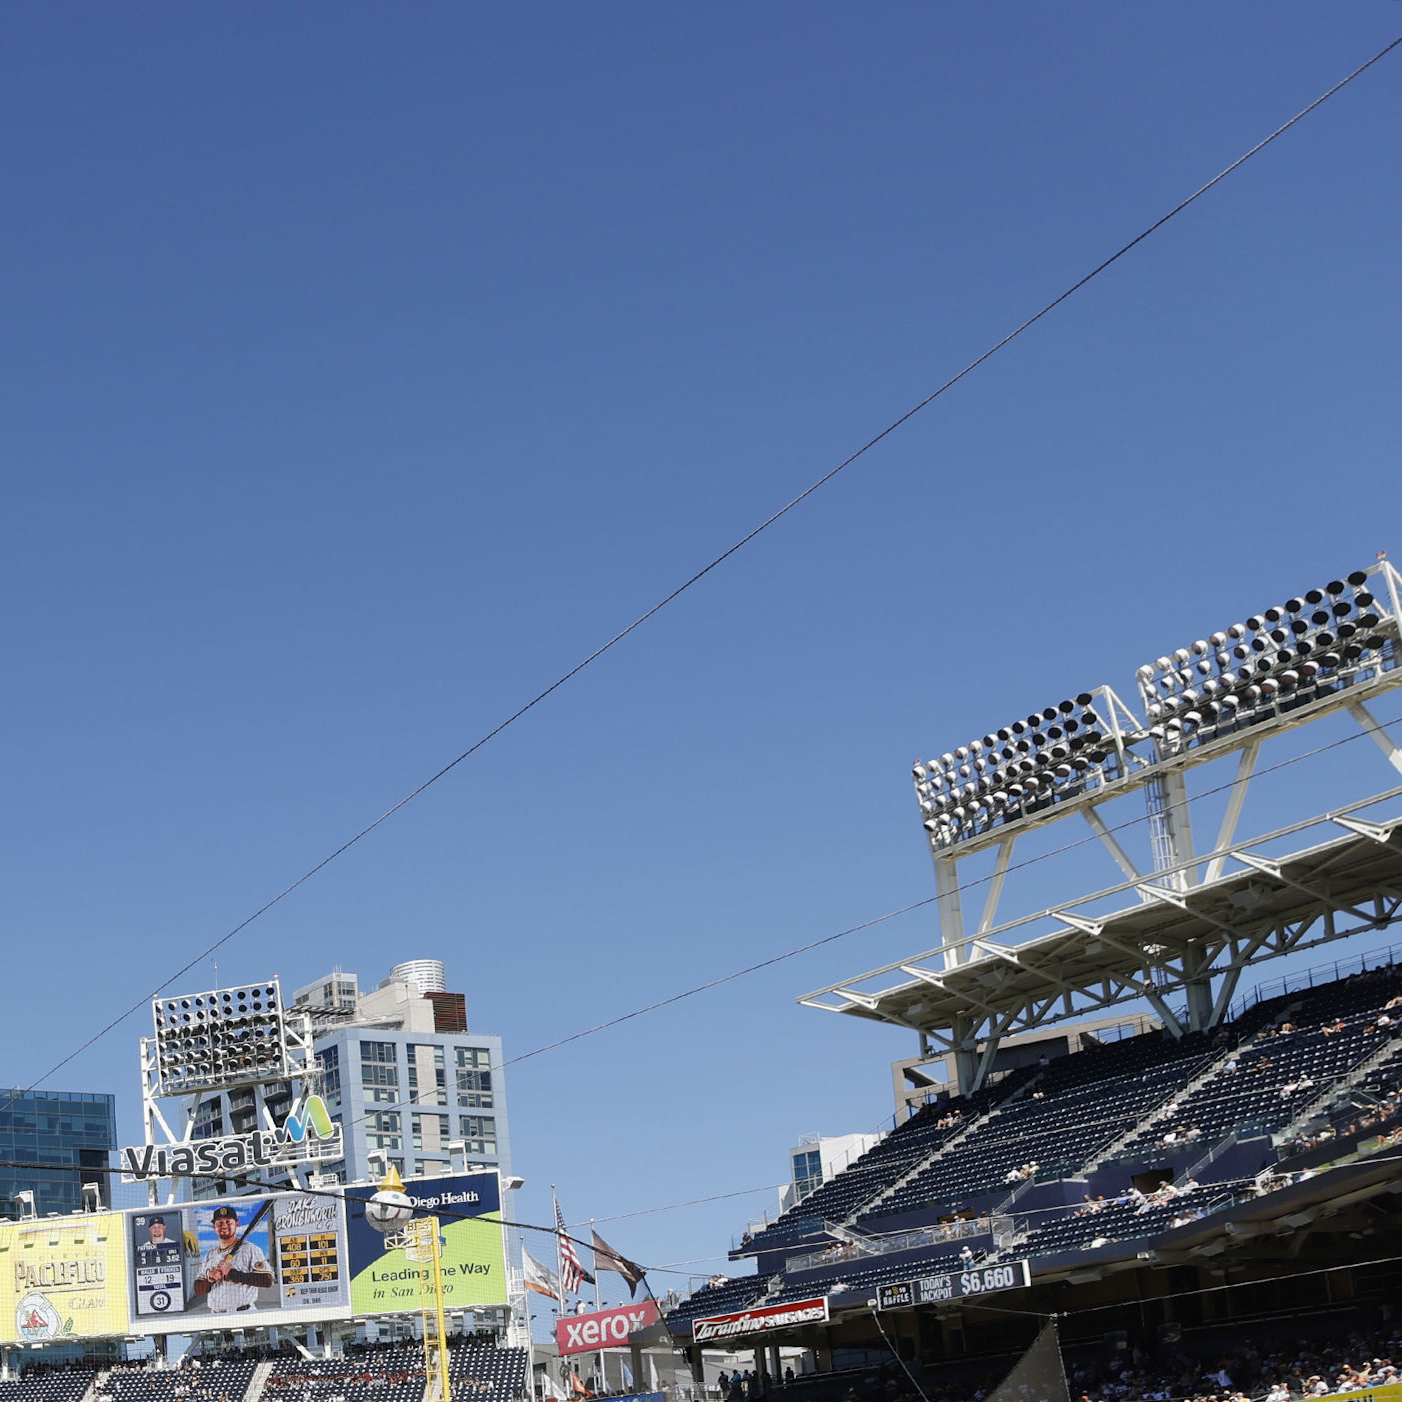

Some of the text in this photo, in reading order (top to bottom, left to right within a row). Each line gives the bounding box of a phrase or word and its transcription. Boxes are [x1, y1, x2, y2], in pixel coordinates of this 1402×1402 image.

[127, 1135, 272, 1182] Viasat
[410, 1191, 479, 1209] Diego Health
[14, 1260, 105, 1292] PACIFICO
[372, 1263, 491, 1283] Leading Way
[920, 1276, 952, 1290] TODAY'S
[920, 1266, 1014, 1301] JACKPOT $6,660
[373, 1287, 414, 1299] in San
[883, 1293, 910, 1306] RAFFLE
[566, 1309, 646, 1349] xerox
[695, 1307, 824, 1339] Tarantino SAUSAGES
